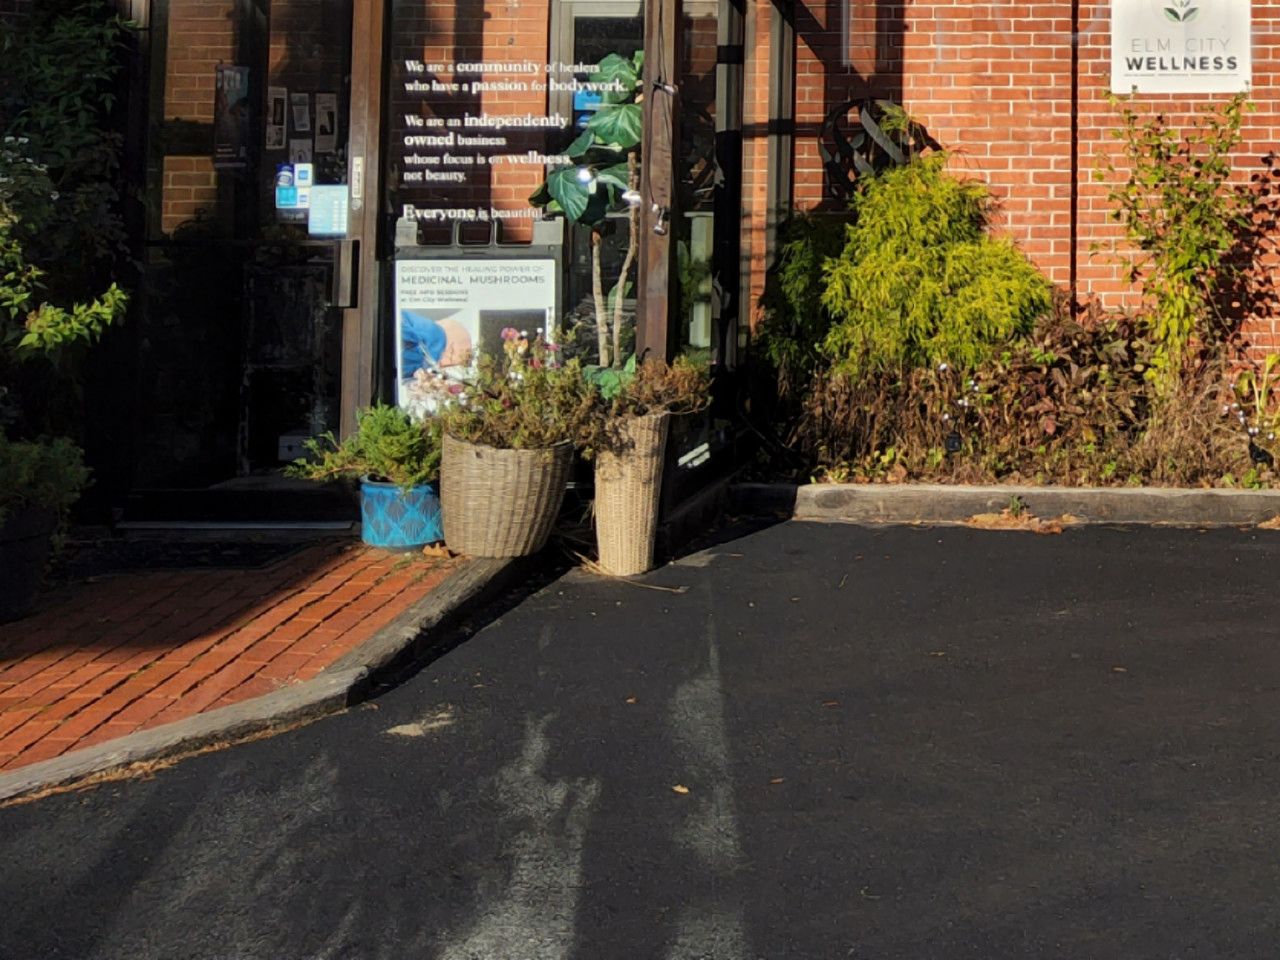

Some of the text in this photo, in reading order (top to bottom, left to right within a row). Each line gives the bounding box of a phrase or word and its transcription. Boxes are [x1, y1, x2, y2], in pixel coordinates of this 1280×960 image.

[1131, 38, 1231, 52] ELM CITY
[405, 60, 424, 72] We
[426, 63, 445, 72] are
[456, 60, 541, 75] community
[545, 61, 556, 72] of
[1125, 56, 1238, 71] WELLNESS
[405, 80, 430, 91] who
[431, 80, 460, 91] have
[462, 83, 469, 91] a
[472, 79, 527, 95] passion
[531, 80, 547, 90] for
[550, 78, 628, 94] bodywork.
[405, 112, 568, 130] We are an independently
[404, 132, 507, 146] owned business
[404, 153, 440, 164] whose
[443, 152, 474, 164] focus
[477, 152, 486, 164] is
[488, 156, 503, 164] on
[403, 169, 467, 183] not beauty.
[403, 204, 476, 220] Everyone
[478, 207, 488, 220] is
[401, 276, 545, 284] MEDICINAL MUSHROOMS
